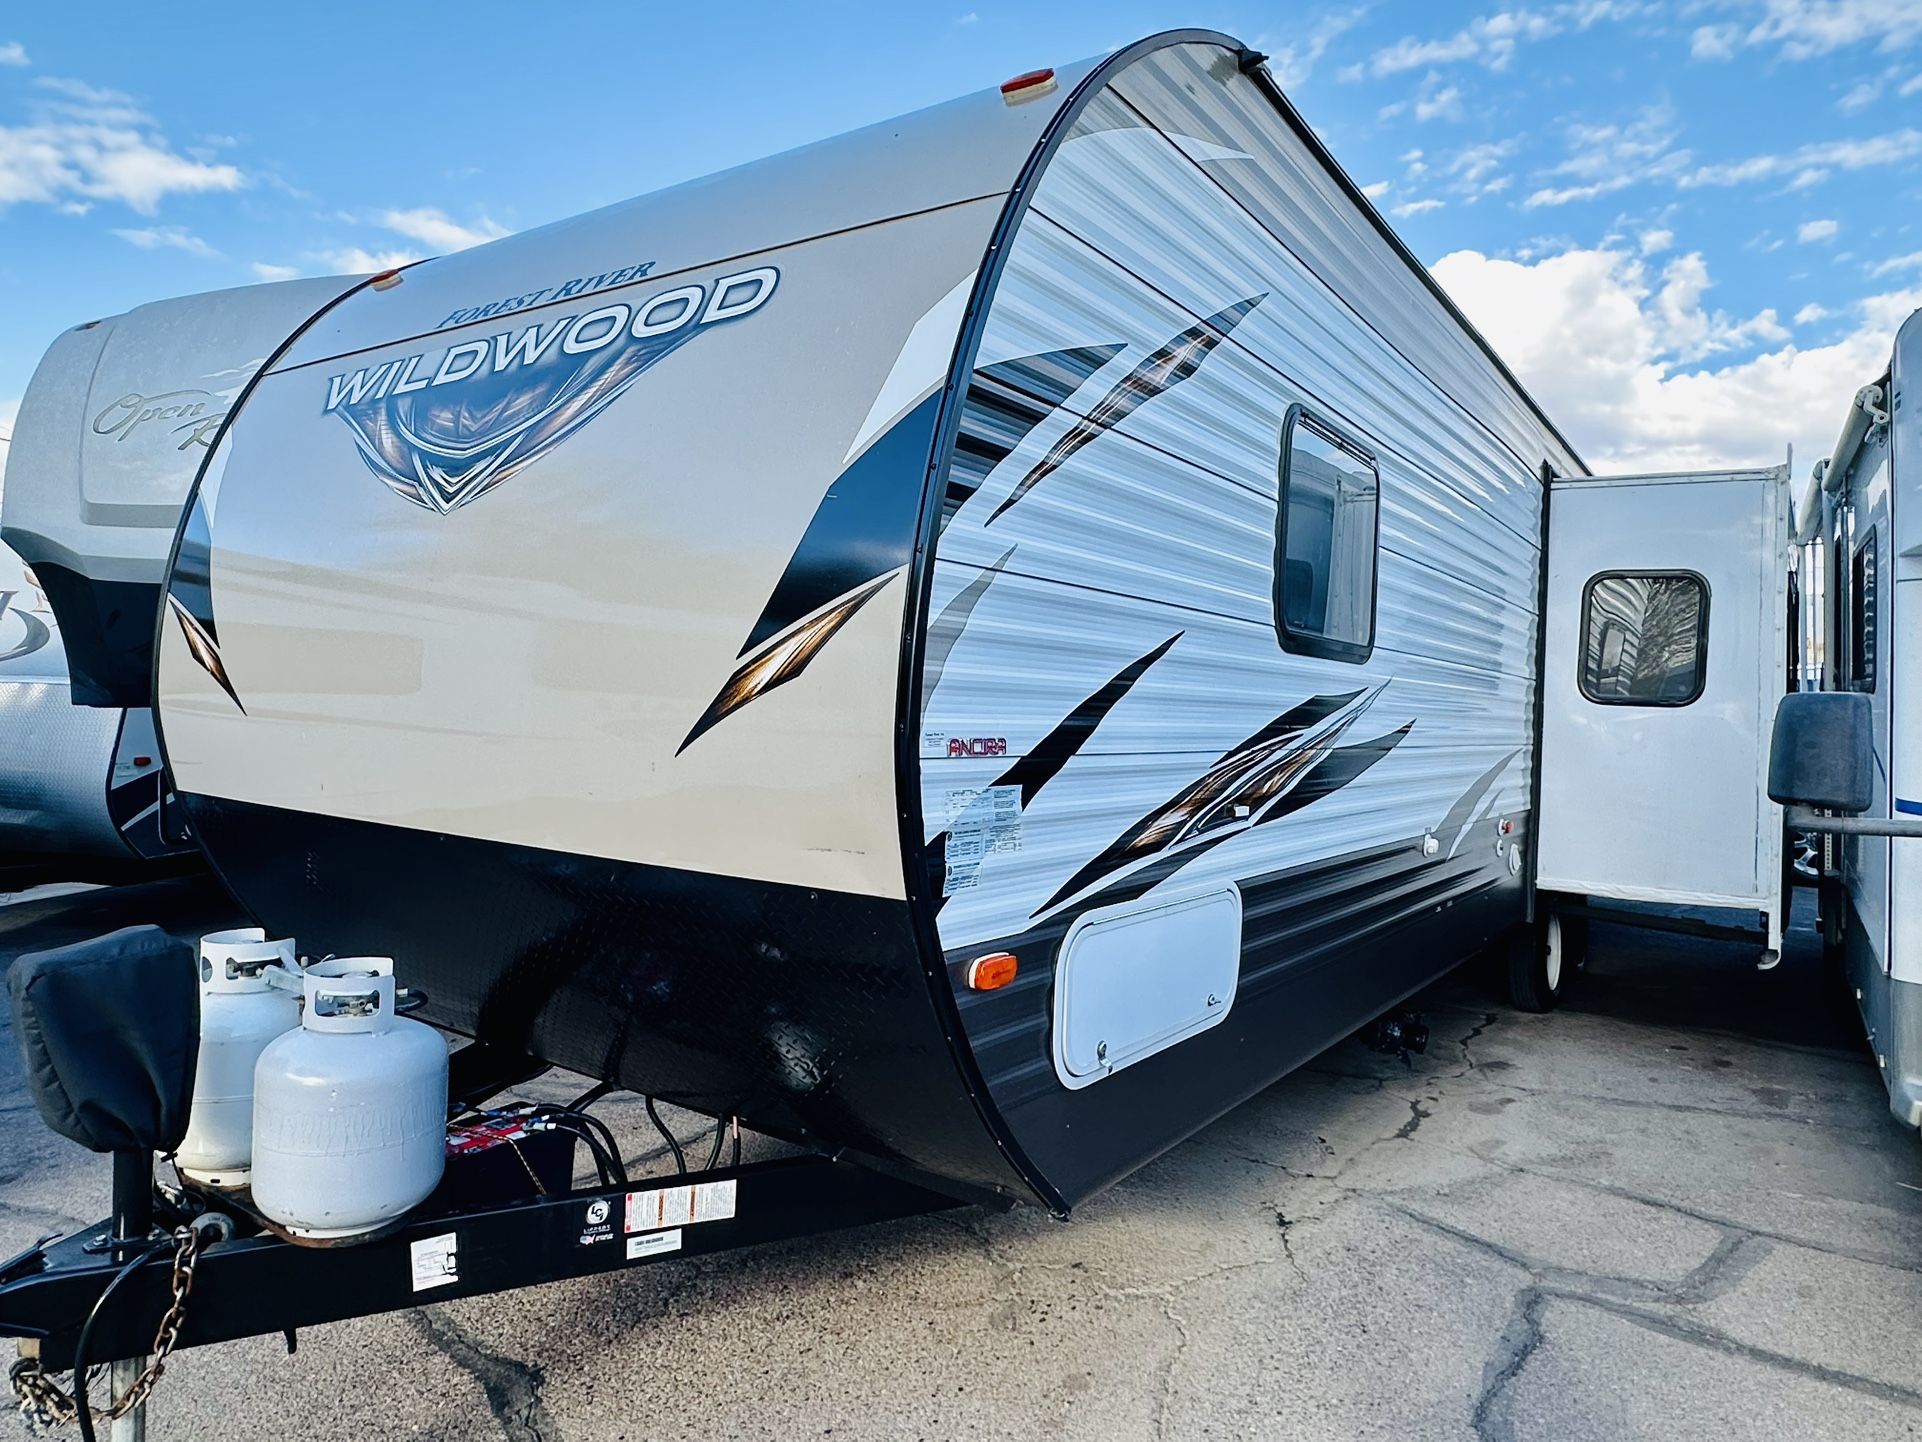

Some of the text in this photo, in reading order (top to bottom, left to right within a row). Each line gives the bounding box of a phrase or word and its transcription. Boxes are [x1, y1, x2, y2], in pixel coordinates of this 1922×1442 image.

[436, 261, 656, 329] FOREST RIVER
[323, 265, 781, 412] WILDWOOD
[93, 388, 214, 441] Open
